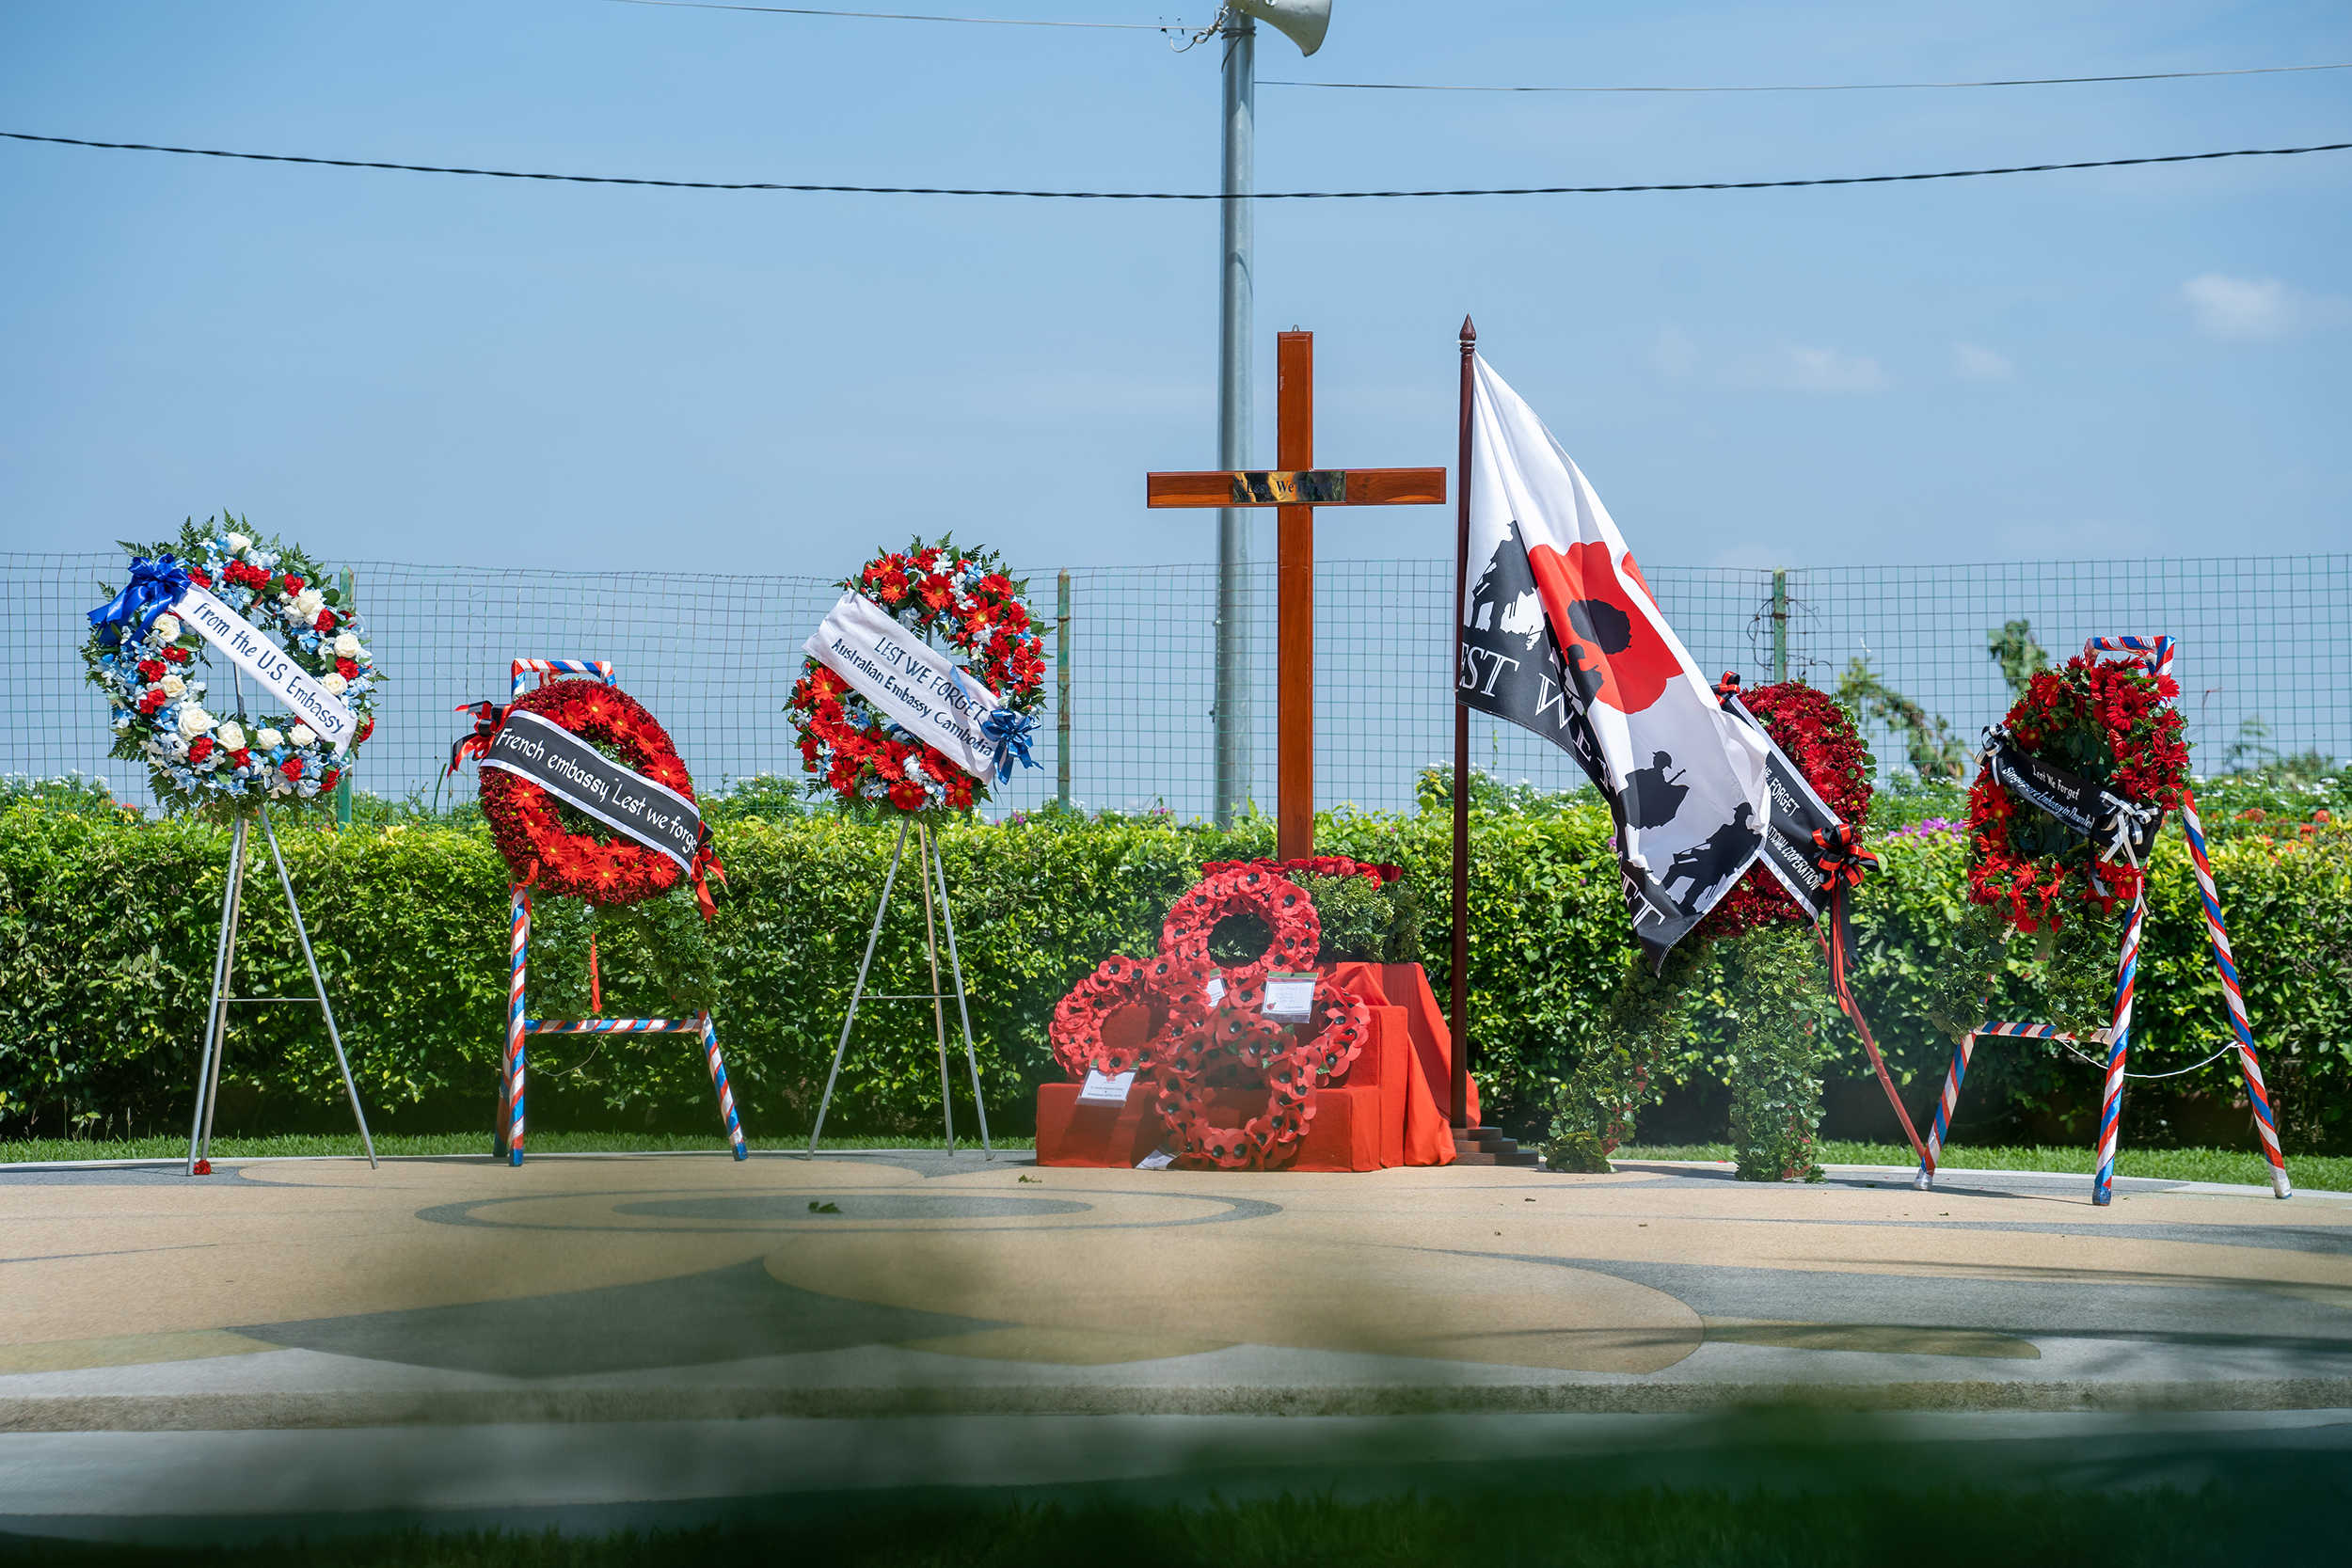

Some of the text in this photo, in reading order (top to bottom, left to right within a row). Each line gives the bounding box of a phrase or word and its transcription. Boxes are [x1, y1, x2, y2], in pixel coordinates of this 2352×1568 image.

[1276, 481, 1295, 494] We
[193, 602, 345, 734] From the U.S. Embassy
[831, 637, 993, 756] Australian Embassy Cambodia
[874, 637, 988, 721] LEST WE FORGET
[1459, 641, 1521, 698] EST
[495, 727, 545, 761] French
[548, 753, 611, 802] embassy
[646, 807, 669, 829] we
[668, 816, 698, 854] forge
[1770, 777, 1801, 817] FORGET
[2002, 766, 2041, 798] Singapore
[2037, 791, 2065, 814] Embassy
[2062, 805, 2071, 816] in
[2032, 764, 2081, 800] Lest We Forget
[1767, 823, 1821, 891] ATIONAL COOPERATION
